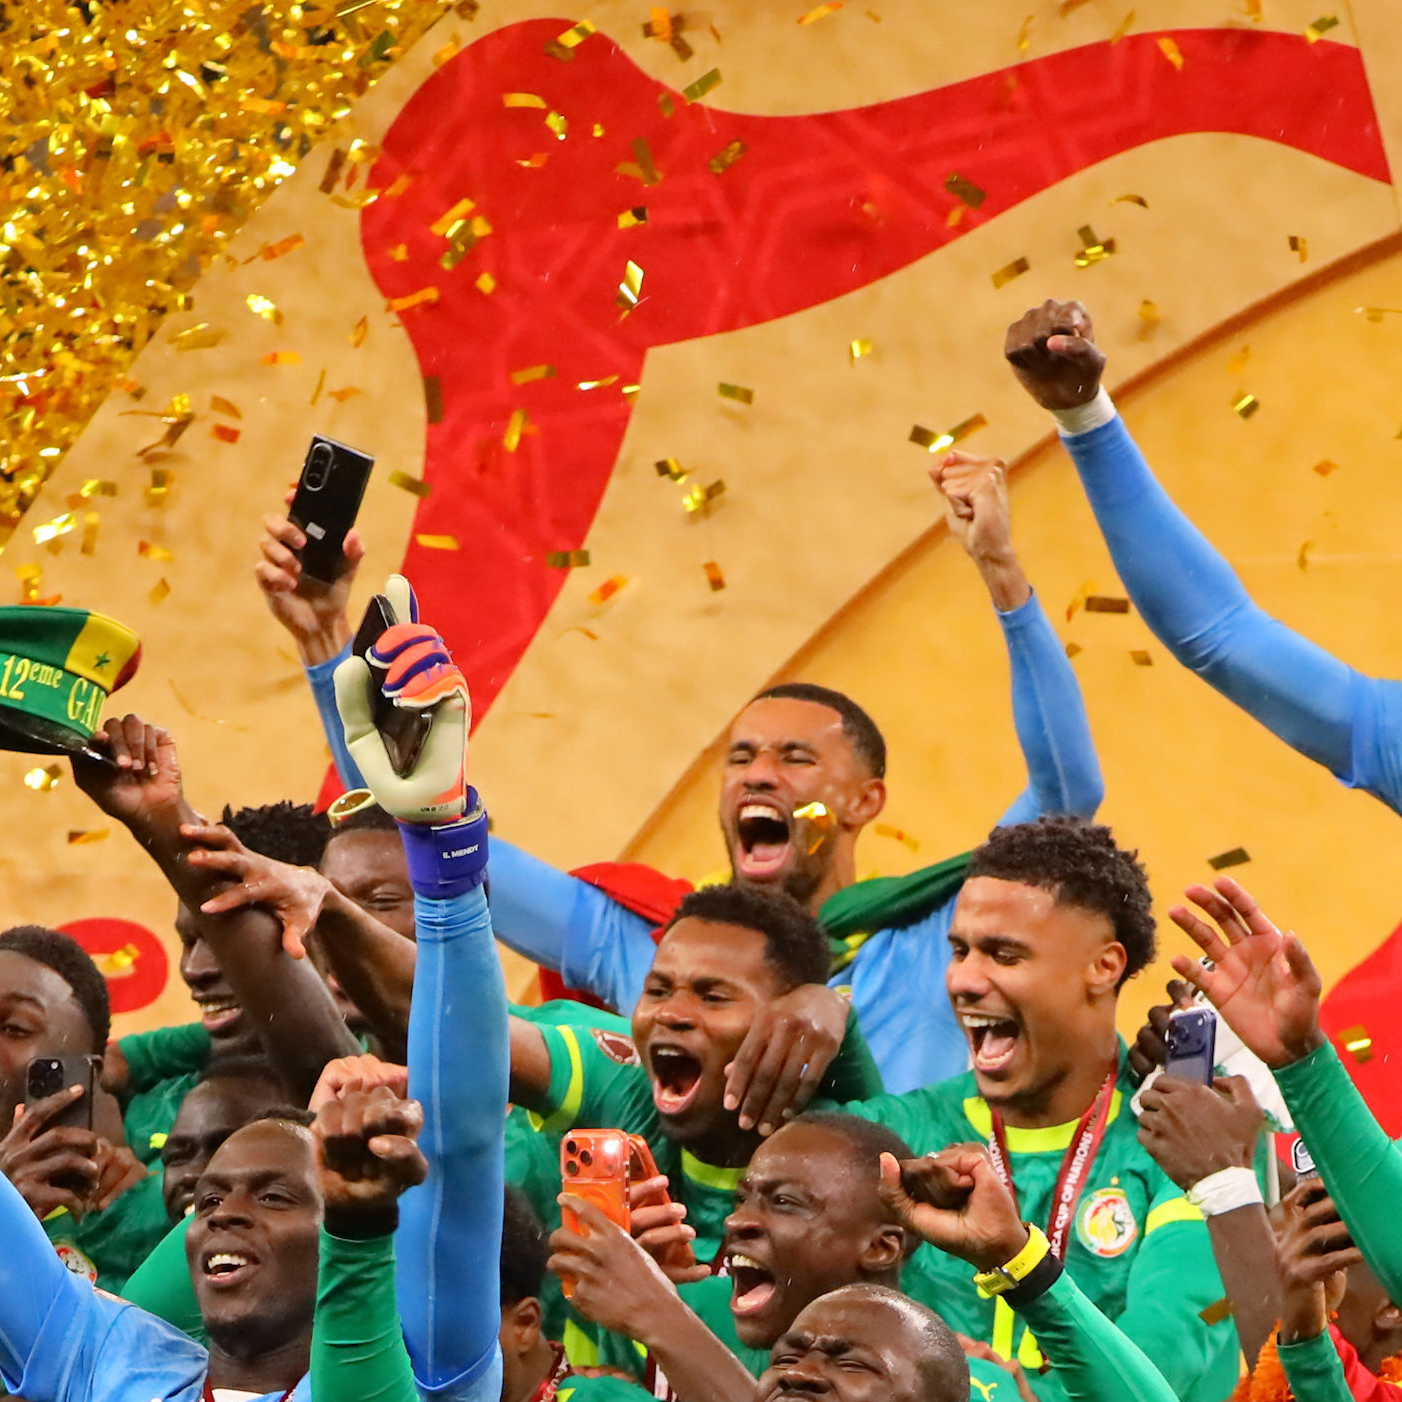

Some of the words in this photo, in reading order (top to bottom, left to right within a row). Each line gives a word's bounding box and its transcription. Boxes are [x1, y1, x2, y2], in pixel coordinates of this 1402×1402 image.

[451, 843, 479, 858] MENDY
[1068, 1131, 1094, 1184] NATIONS
[1061, 1184, 1076, 1203] OF
[1055, 1204, 1070, 1229] CUP
